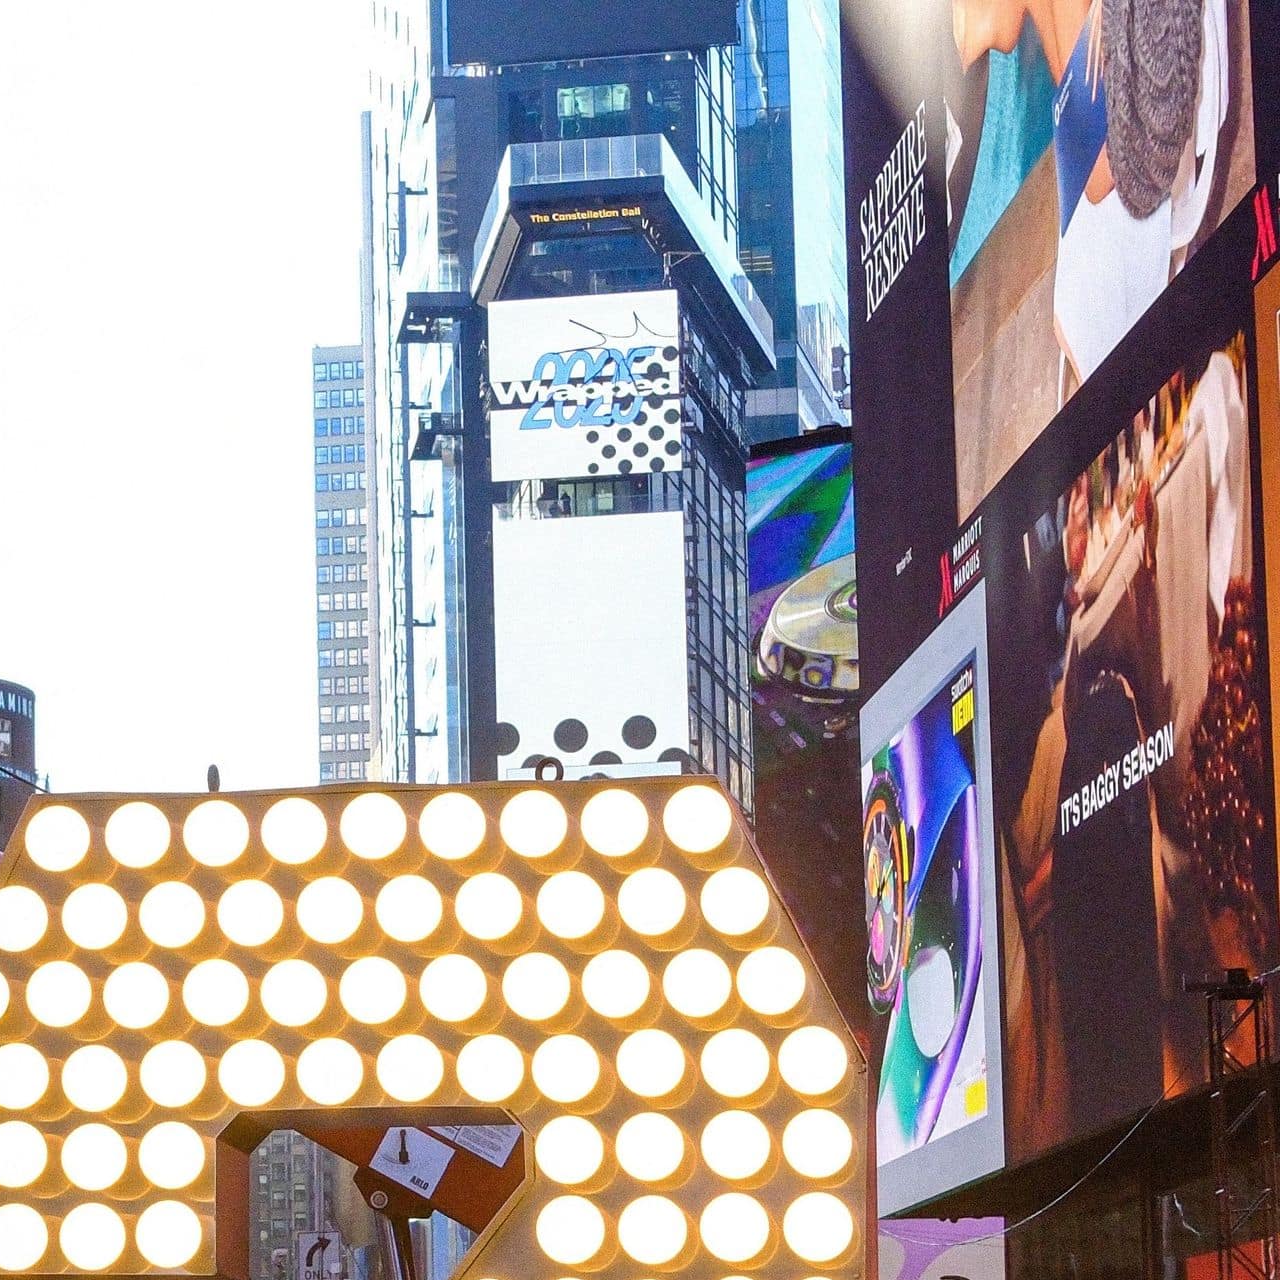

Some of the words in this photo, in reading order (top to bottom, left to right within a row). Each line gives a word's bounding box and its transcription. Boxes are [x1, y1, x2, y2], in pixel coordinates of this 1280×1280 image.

[860, 99, 928, 265] SAPPHIRE
[529, 214, 550, 224] The
[551, 209, 619, 223] Constellation
[621, 206, 641, 218] Ball
[864, 173, 926, 322] RESERVE
[490, 371, 679, 406] Wrapped
[952, 515, 983, 566] MARRIOTT
[953, 548, 980, 594] MARQUIS
[1060, 792, 1081, 836] IT'S
[1081, 760, 1121, 821] BAGGY
[1122, 720, 1174, 791] SEASON
[304, 1269, 333, 1280] ONLY
